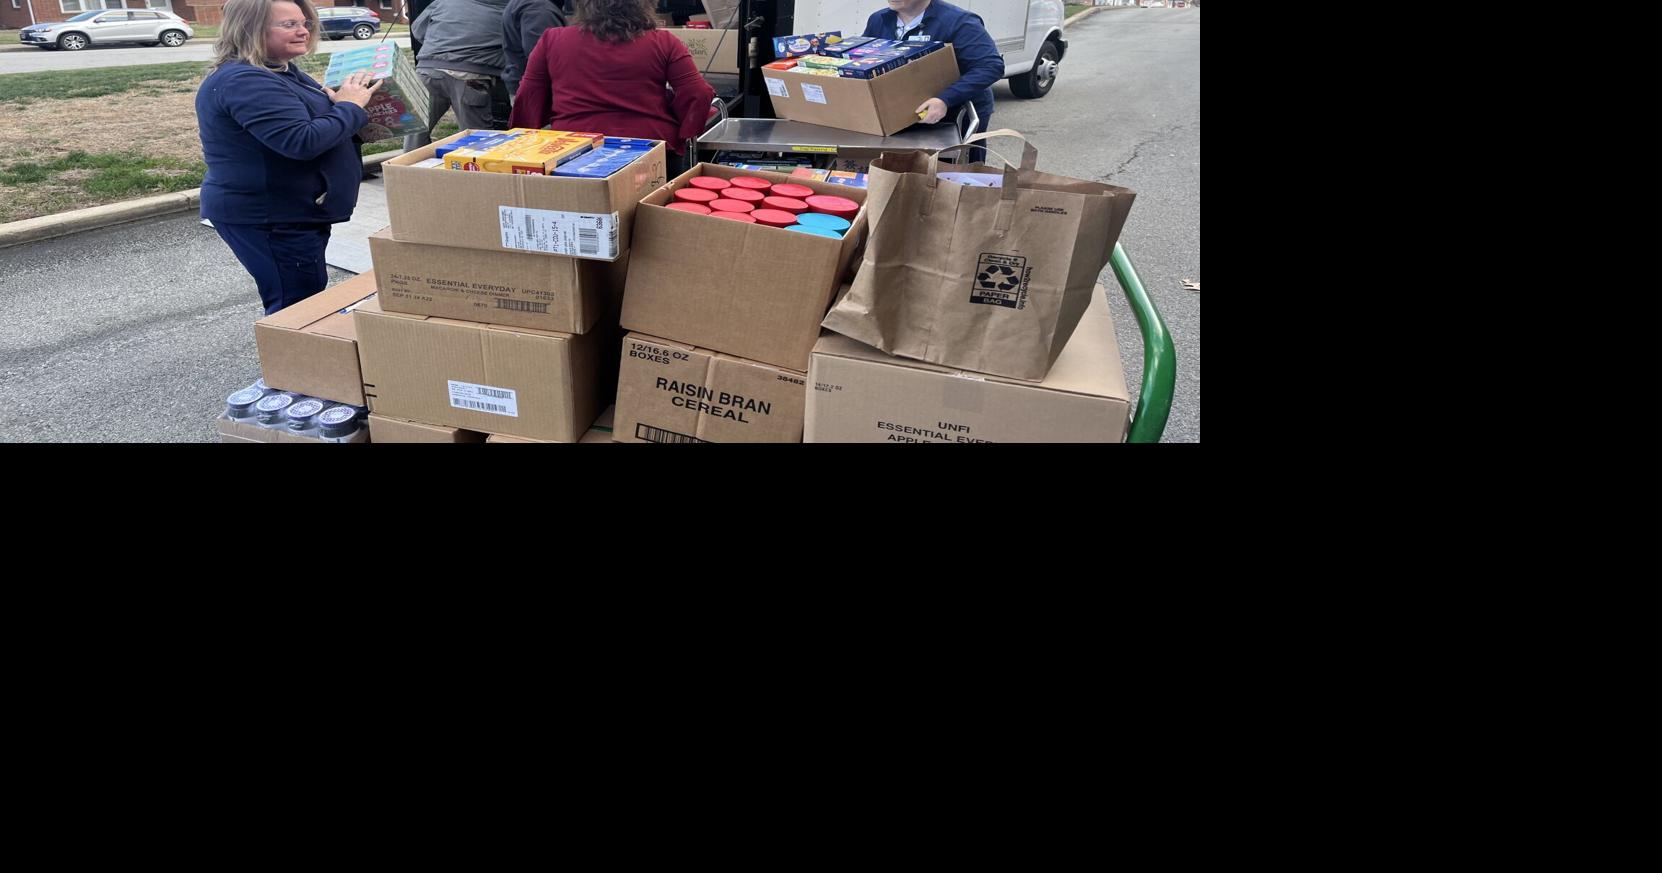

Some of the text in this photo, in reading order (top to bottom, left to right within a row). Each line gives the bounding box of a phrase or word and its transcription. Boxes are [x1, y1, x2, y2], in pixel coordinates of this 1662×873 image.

[426, 278, 516, 293] ESSENTIAL EVERYDAY
[979, 291, 1010, 299] PAPER
[629, 350, 671, 365] BOXES
[631, 343, 690, 362] 12/16.6 OZ
[656, 376, 771, 415] RAISIN BRAN
[671, 396, 749, 424] CEREAL
[877, 421, 953, 441] ESSENTIAL
[937, 421, 971, 434] UNFI
